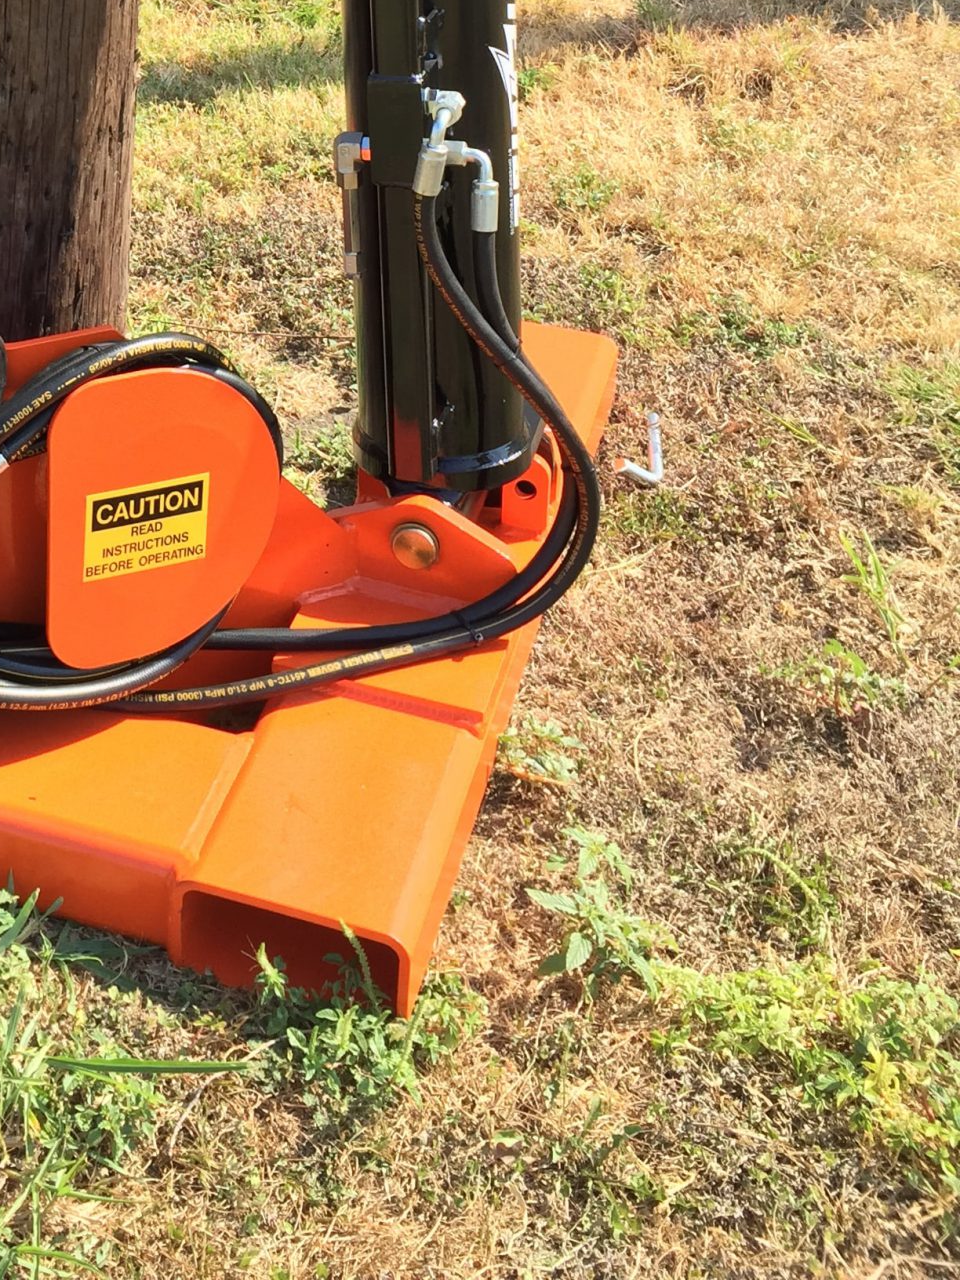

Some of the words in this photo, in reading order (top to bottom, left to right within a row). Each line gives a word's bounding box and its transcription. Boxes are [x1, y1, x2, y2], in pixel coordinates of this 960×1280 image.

[128, 343, 156, 359] MSHA
[88, 350, 127, 375] IC-40/26
[31, 389, 54, 410] SAE
[96, 487, 199, 525] CAUTION
[130, 521, 163, 537] READ
[102, 531, 189, 559] INSTRUCTIONS
[85, 558, 134, 578] BEFORE
[138, 544, 204, 568] OPERATING
[342, 651, 382, 668] TOUGH
[306, 661, 343, 678] COVER
[249, 680, 267, 692] WP
[267, 671, 307, 688] 451TC-8
[154, 693, 175, 703] PSI)
[176, 689, 203, 701] (3000
[204, 687, 226, 698] MPa
[226, 684, 248, 696] 21.0
